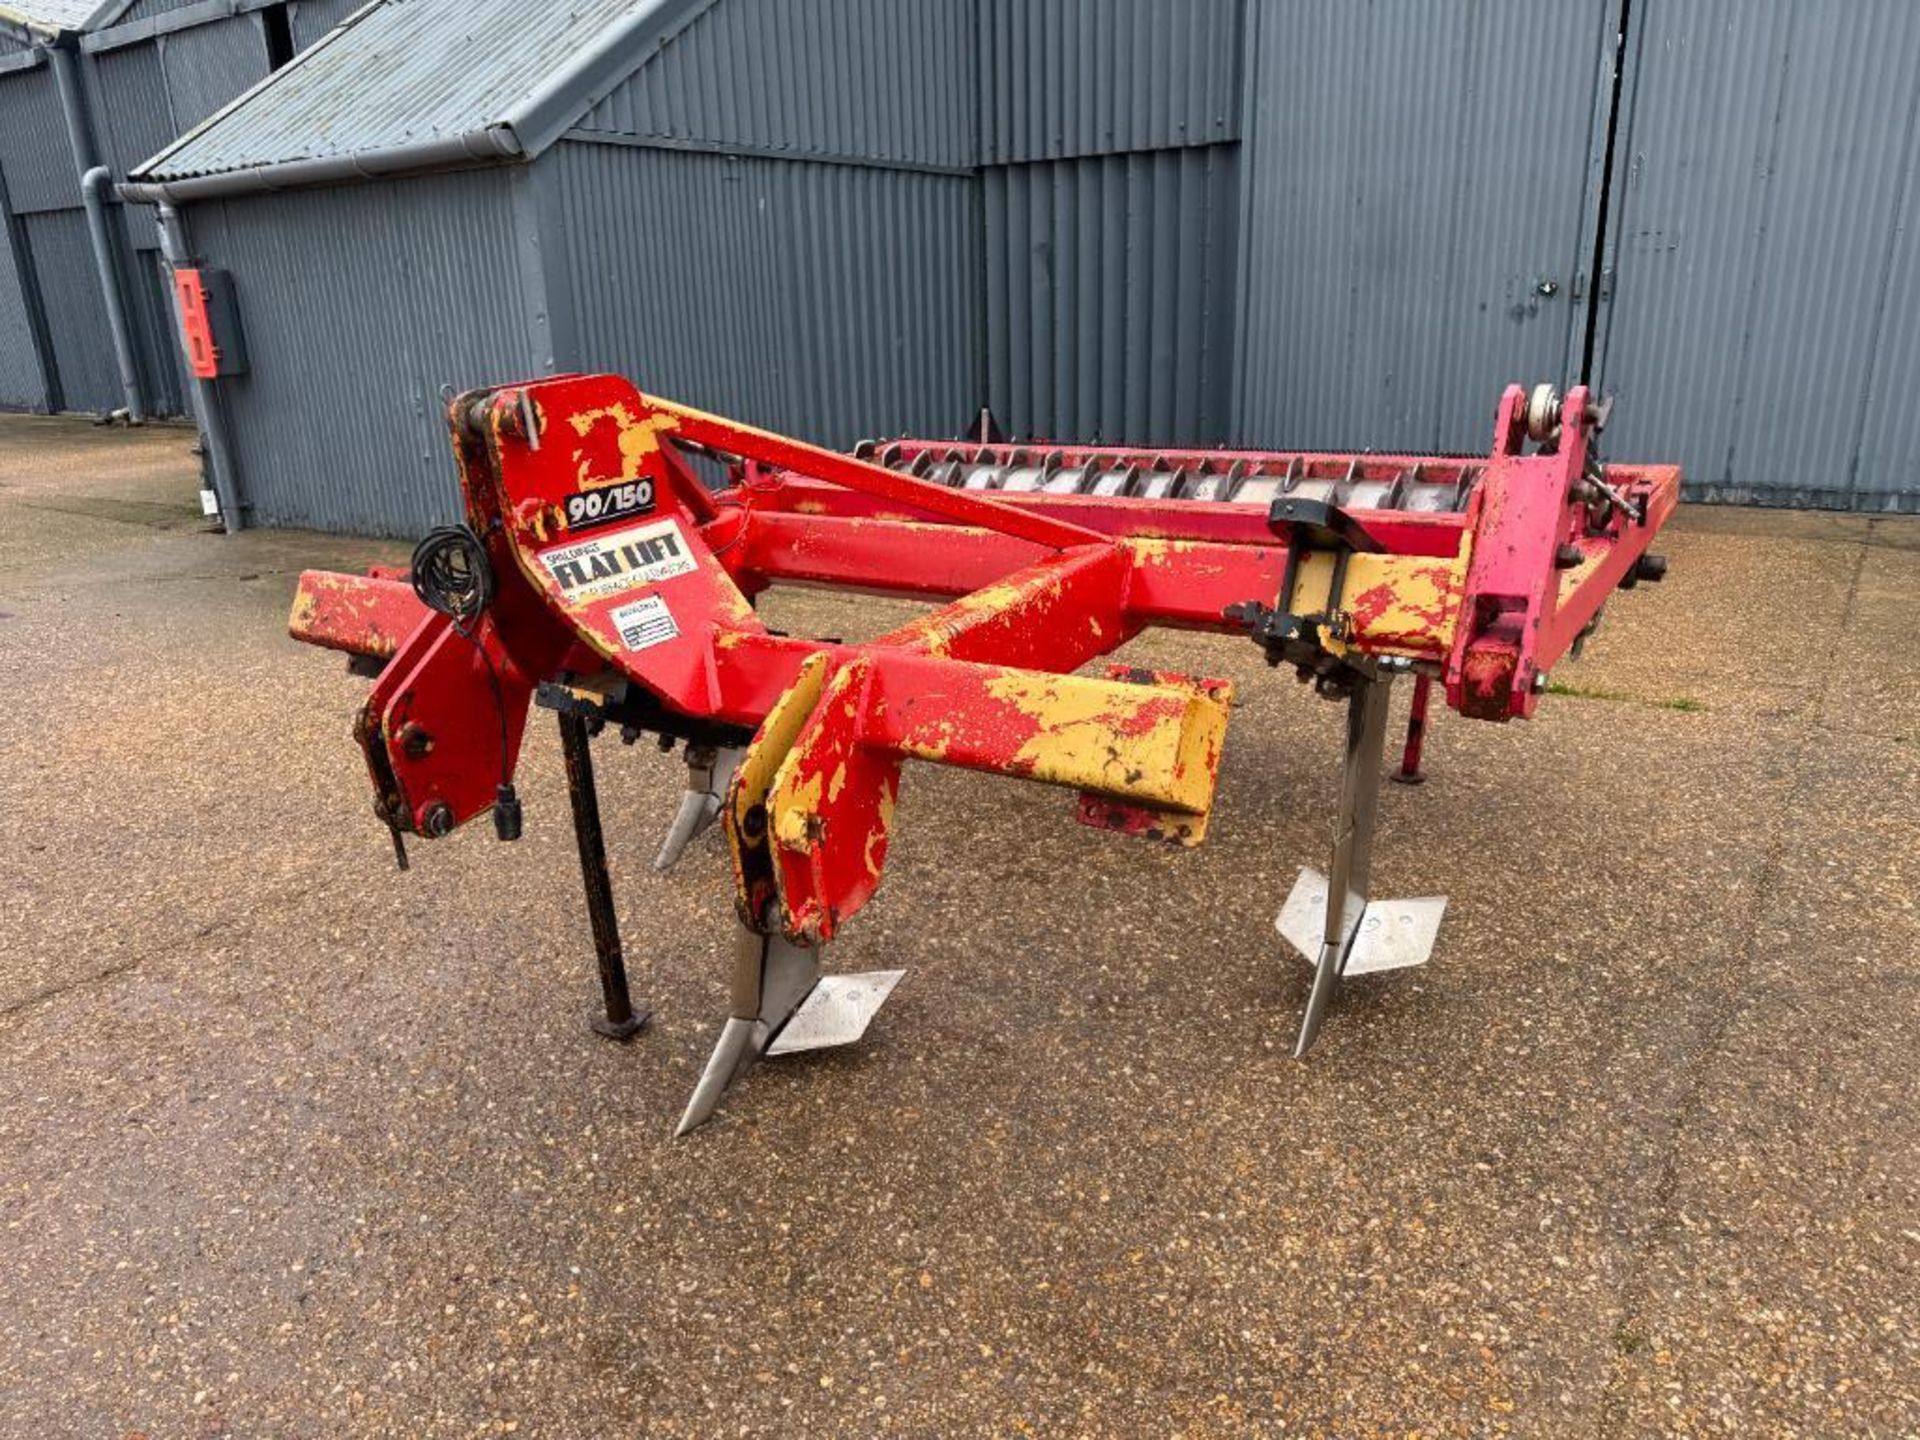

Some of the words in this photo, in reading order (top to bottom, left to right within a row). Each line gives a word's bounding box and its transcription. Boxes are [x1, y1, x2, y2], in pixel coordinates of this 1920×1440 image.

[569, 481, 652, 523] 90/150
[552, 550, 622, 589] FLAT
[621, 532, 681, 570] LIFT
